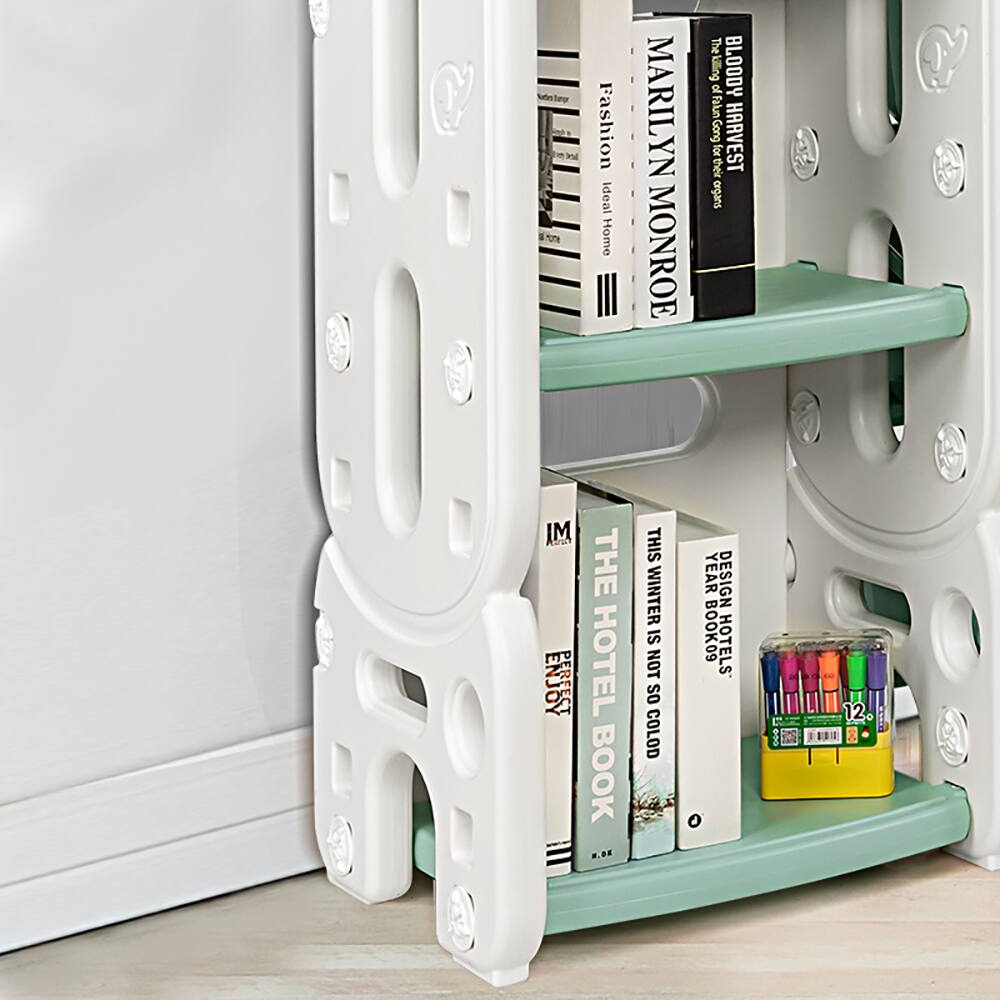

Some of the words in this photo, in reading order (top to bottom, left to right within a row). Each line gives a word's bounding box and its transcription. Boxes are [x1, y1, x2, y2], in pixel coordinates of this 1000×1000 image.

[711, 38, 722, 54] The
[725, 36, 743, 97] BLOODY
[648, 36, 675, 178] MARILYN
[711, 84, 723, 94] of
[711, 95, 723, 119] Falun
[600, 82, 614, 169] Fashion
[709, 119, 723, 142] Gong
[726, 102, 744, 172] HARVEST
[712, 145, 724, 156] for
[712, 158, 724, 178] their
[602, 181, 612, 214] Ideal
[710, 180, 722, 209] organs
[603, 218, 612, 256] Home
[649, 186, 678, 320] MONROE
[594, 527, 619, 597] THE
[647, 527, 662, 563] THIS
[704, 552, 718, 594] YEAR
[719, 550, 733, 608] DESIGN
[647, 565, 662, 626] WINTER
[646, 629, 661, 647] IS
[705, 599, 717, 663] BOOK09
[592, 604, 617, 717] HOTEL
[646, 649, 661, 680] NOT
[545, 652, 561, 717] ENJOY
[559, 650, 572, 716] PERFECT
[646, 684, 661, 705] SO
[646, 706, 661, 760] COLOD
[845, 703, 865, 721] 12
[591, 724, 617, 824] BOOK
